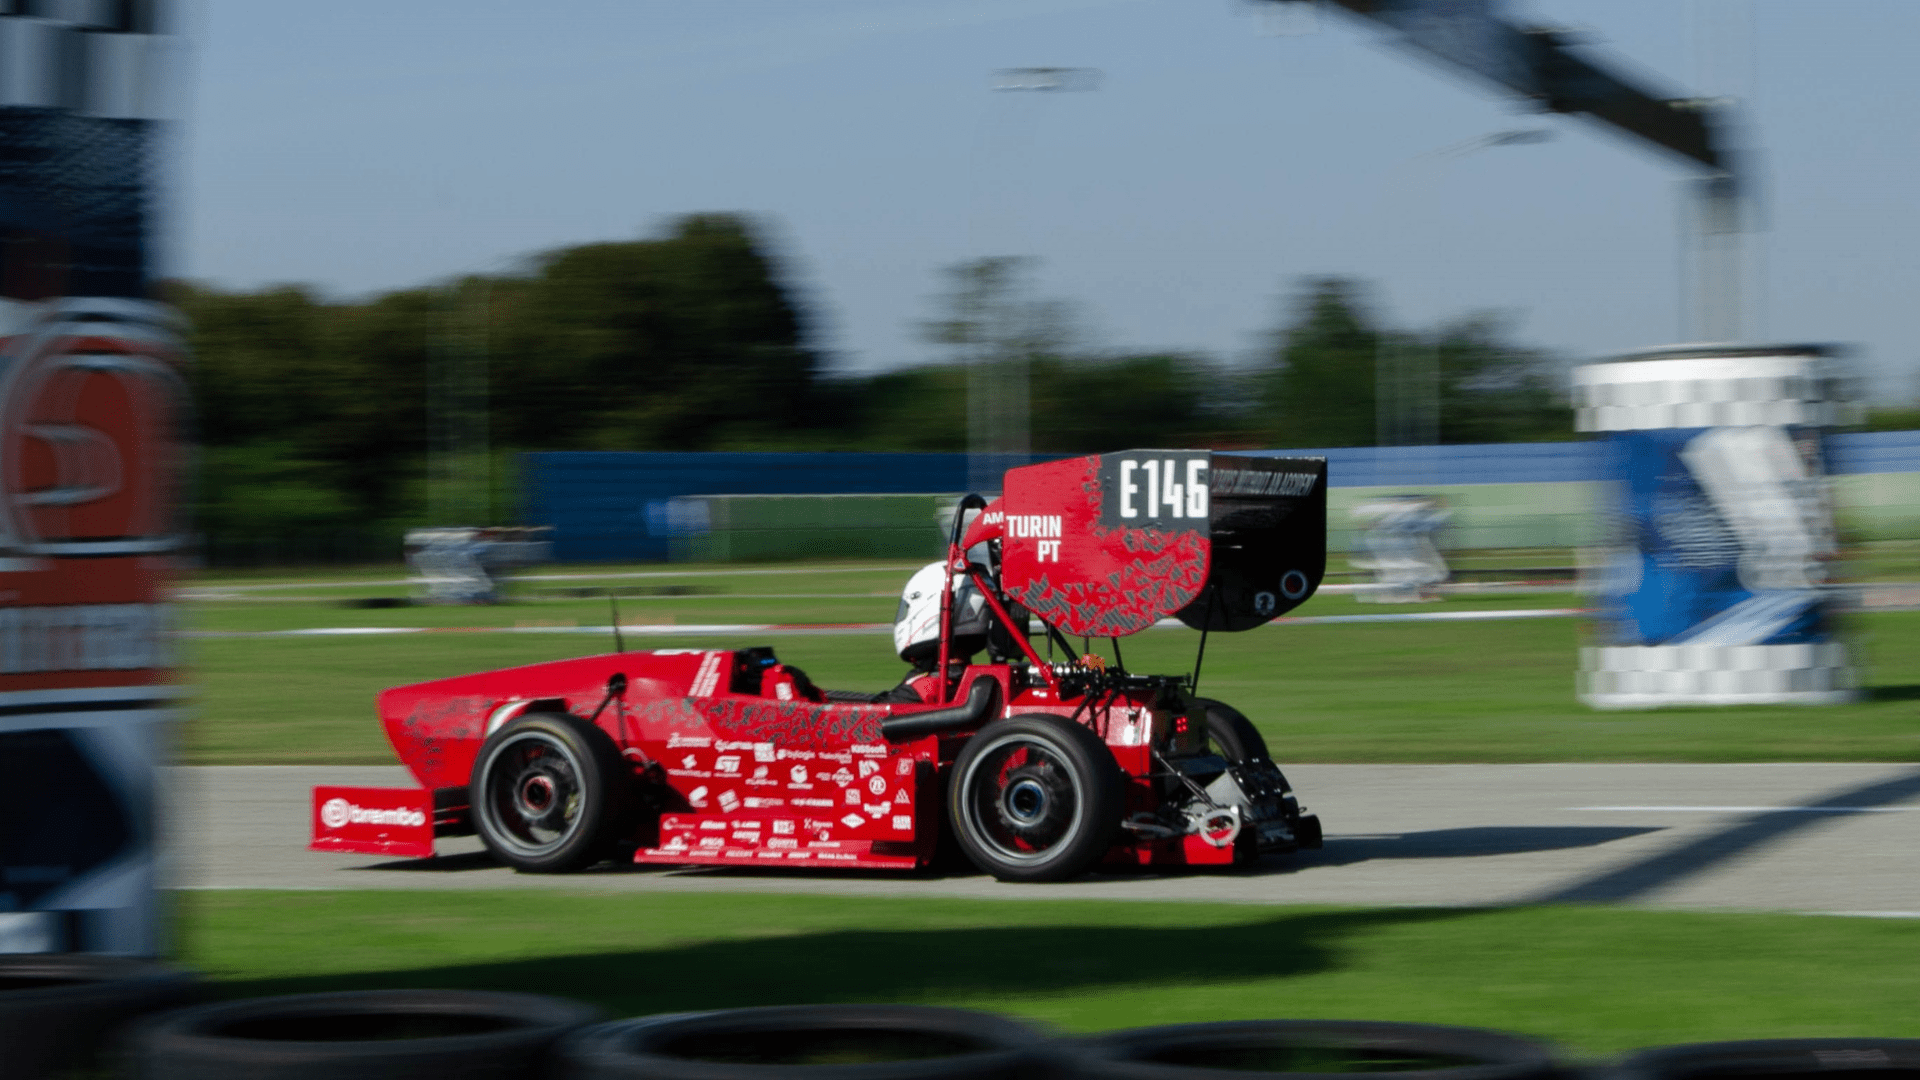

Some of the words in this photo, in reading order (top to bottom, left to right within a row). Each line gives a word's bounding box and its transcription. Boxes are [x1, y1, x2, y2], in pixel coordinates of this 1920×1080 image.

[1120, 459, 1208, 518] E146
[1006, 515, 1062, 538] TURIN
[1037, 540, 1062, 563] PT
[349, 803, 426, 827] brembo
